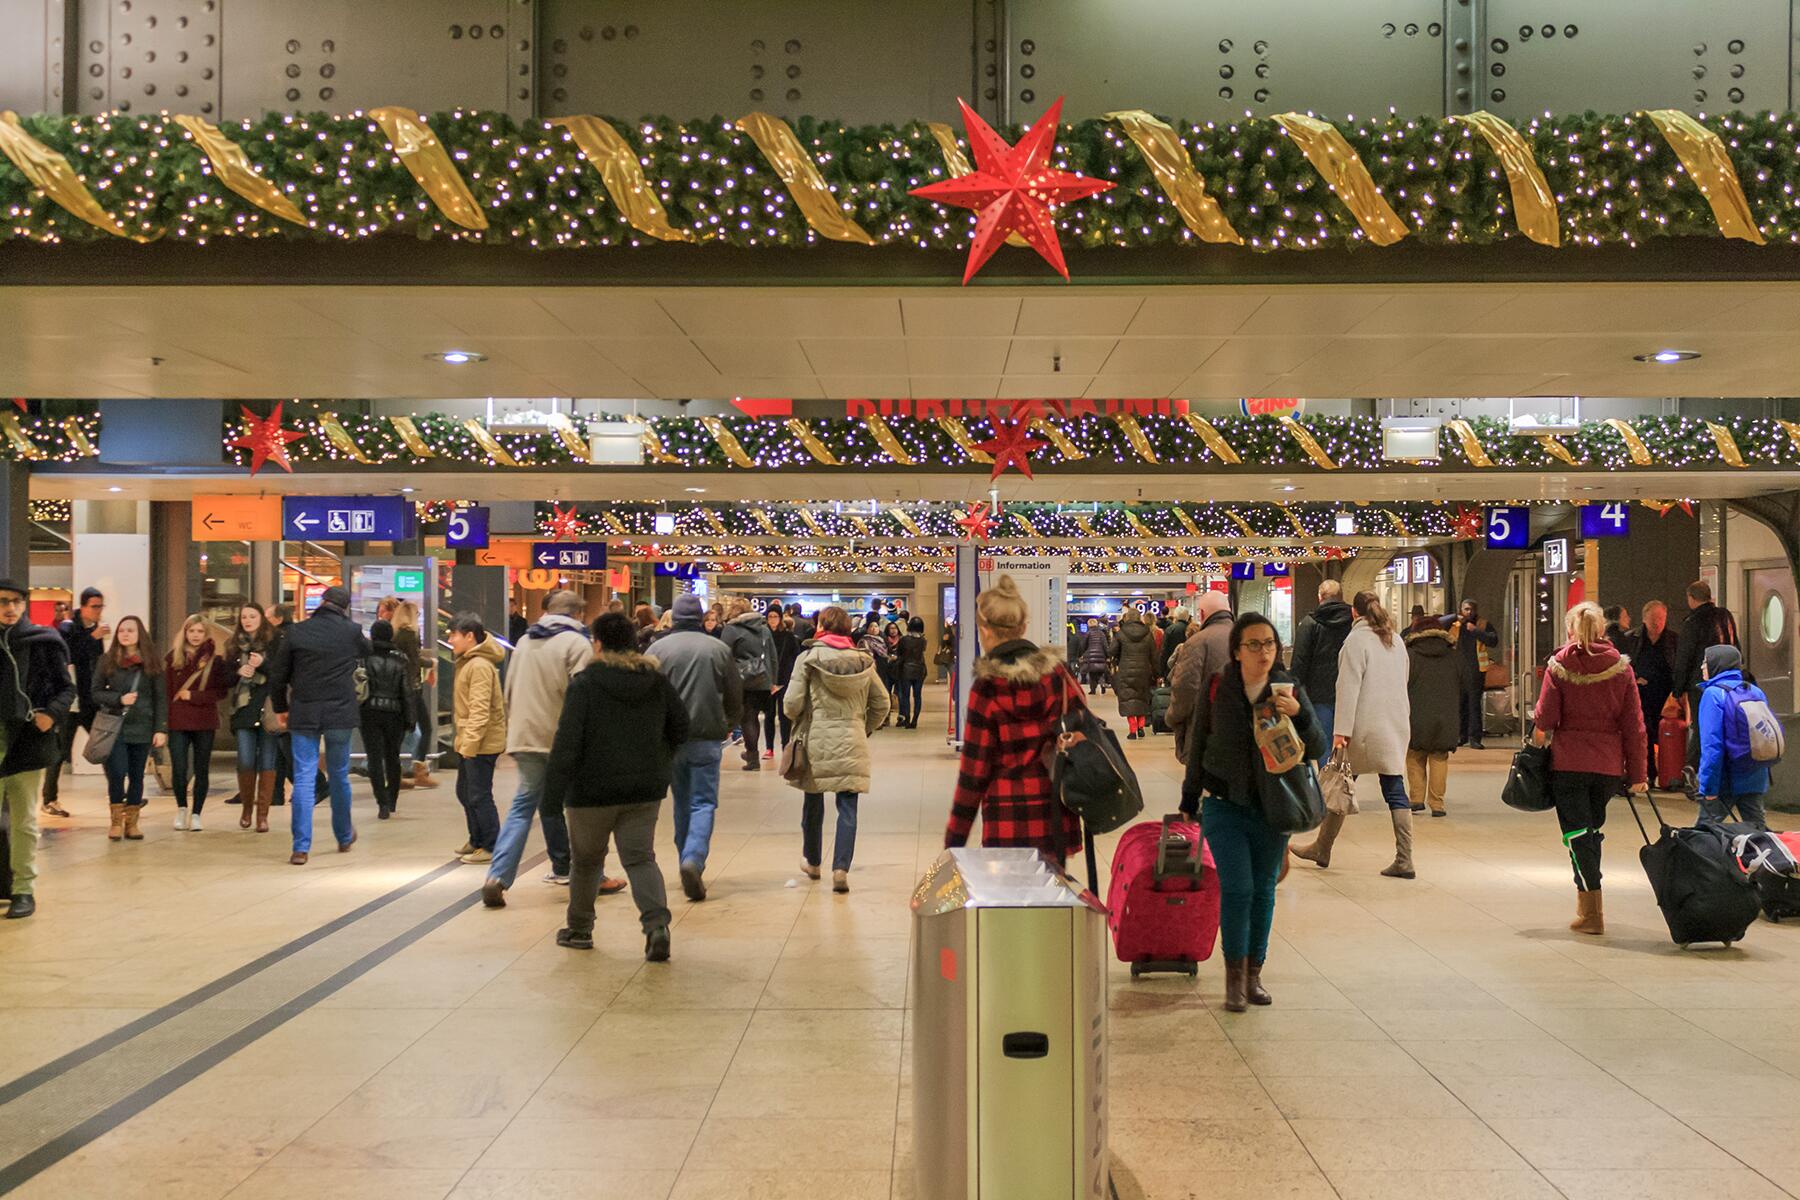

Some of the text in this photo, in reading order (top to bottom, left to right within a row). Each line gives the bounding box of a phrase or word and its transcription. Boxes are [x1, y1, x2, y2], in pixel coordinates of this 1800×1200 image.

[449, 508, 470, 540] 5
[1489, 508, 1511, 540] 5
[1600, 502, 1626, 527] 4
[978, 560, 992, 570] DB
[1150, 601, 1160, 614] 8
